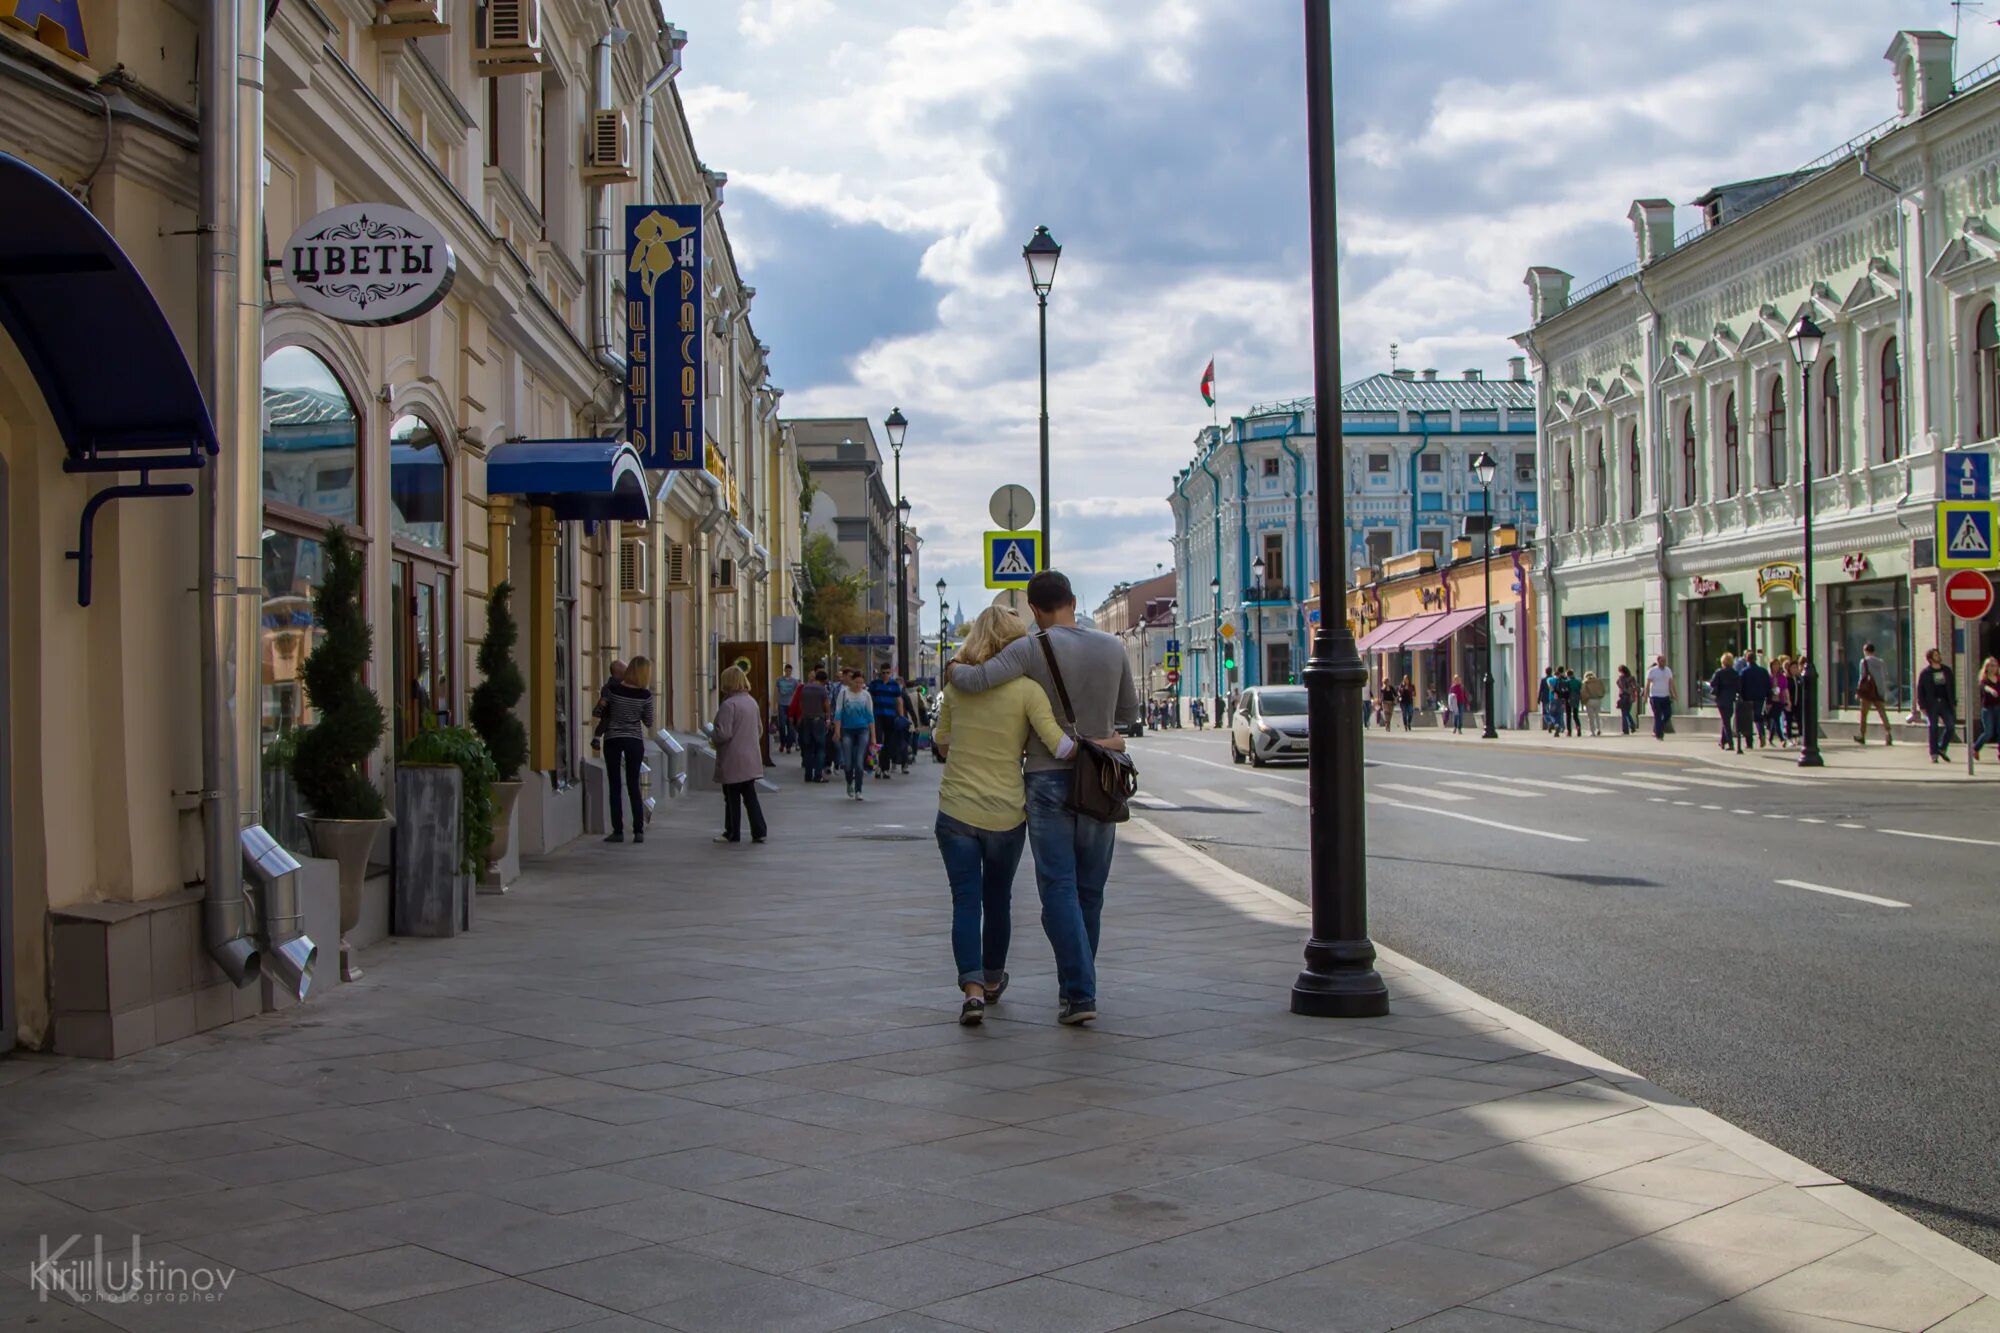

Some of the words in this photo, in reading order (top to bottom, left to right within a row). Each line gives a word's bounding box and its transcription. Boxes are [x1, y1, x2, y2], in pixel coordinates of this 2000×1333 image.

[292, 245, 433, 283] ЦВЕТЫ
[628, 301, 647, 454] ЦЕНТР
[671, 238, 695, 461] КРАСОТЫ
